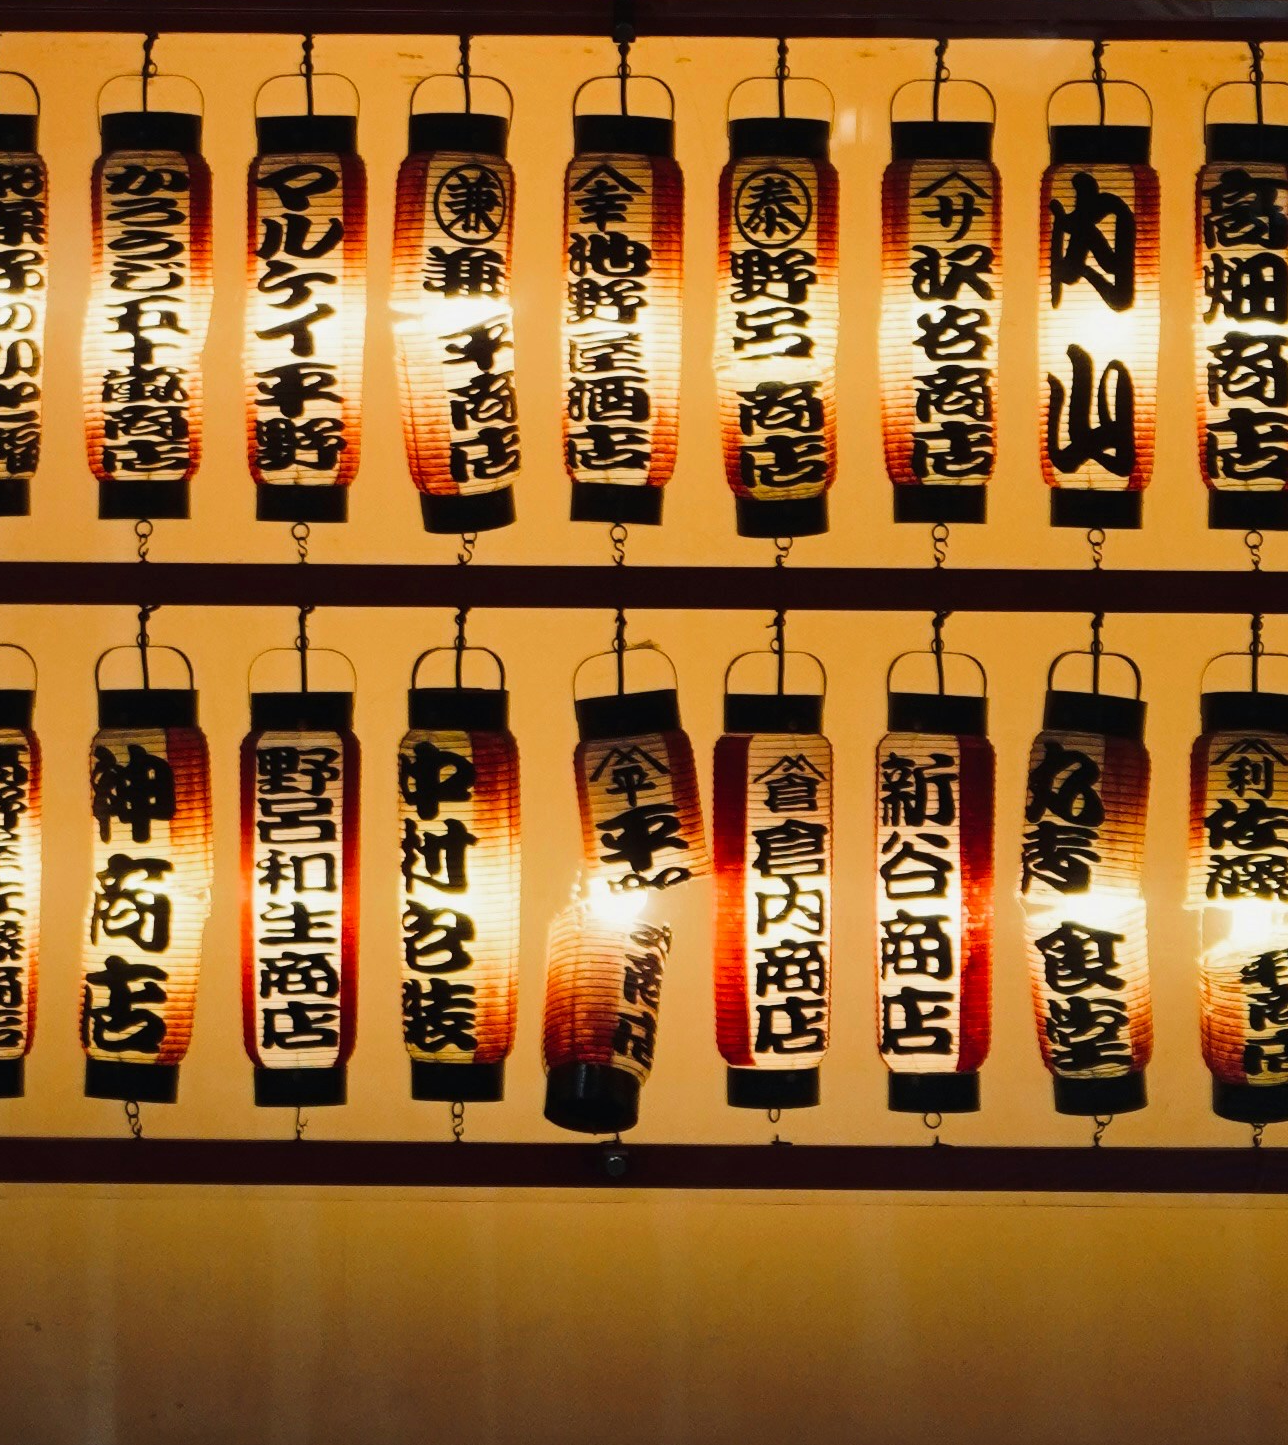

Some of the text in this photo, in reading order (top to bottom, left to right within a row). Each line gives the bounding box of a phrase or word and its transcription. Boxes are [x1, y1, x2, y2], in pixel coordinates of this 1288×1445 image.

[255, 164, 347, 471] マルケイ平野
[1047, 171, 1137, 476] 内山
[255, 746, 340, 1051] 野呂和生商店
[880, 752, 958, 1056] 新谷商店
